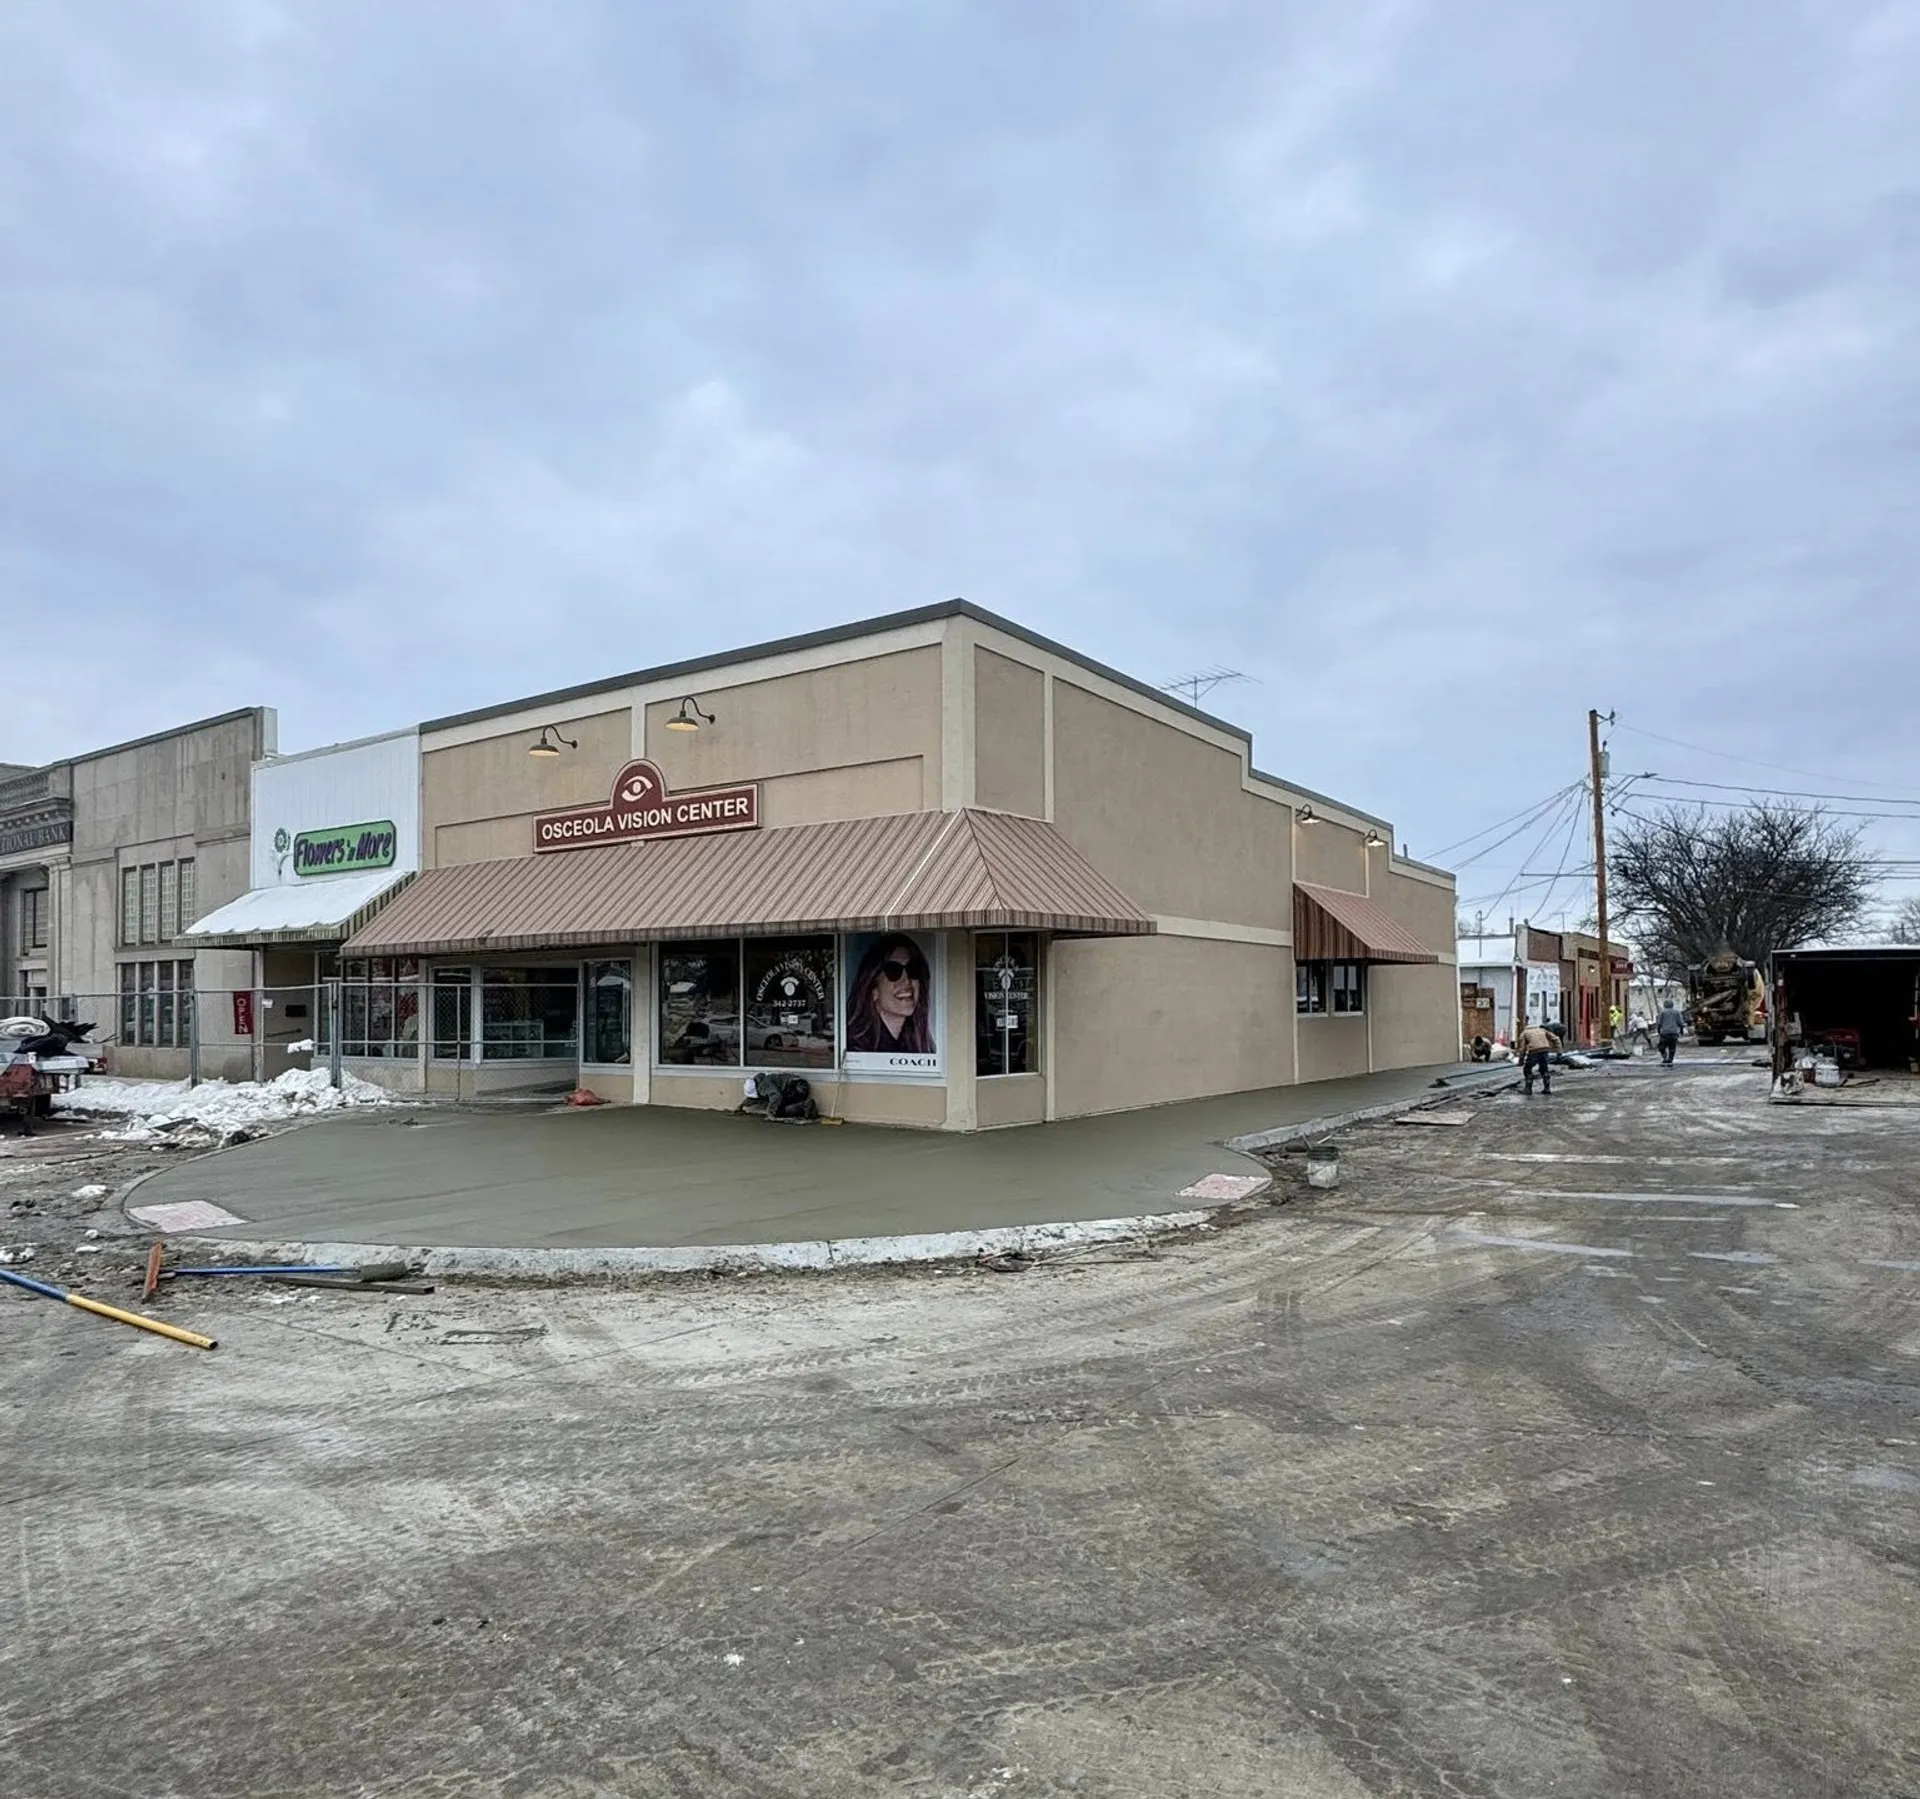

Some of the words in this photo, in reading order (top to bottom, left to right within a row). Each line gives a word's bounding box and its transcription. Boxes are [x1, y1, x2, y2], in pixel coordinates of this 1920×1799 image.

[38, 824, 67, 845] BANK
[542, 816, 614, 840] OSCEOLA
[617, 808, 672, 830] VISION
[677, 797, 749, 822] CENTER
[297, 838, 345, 868] Flowers
[356, 831, 393, 860] More
[237, 998, 249, 1034] OPEN
[889, 1058, 937, 1067] COACH
